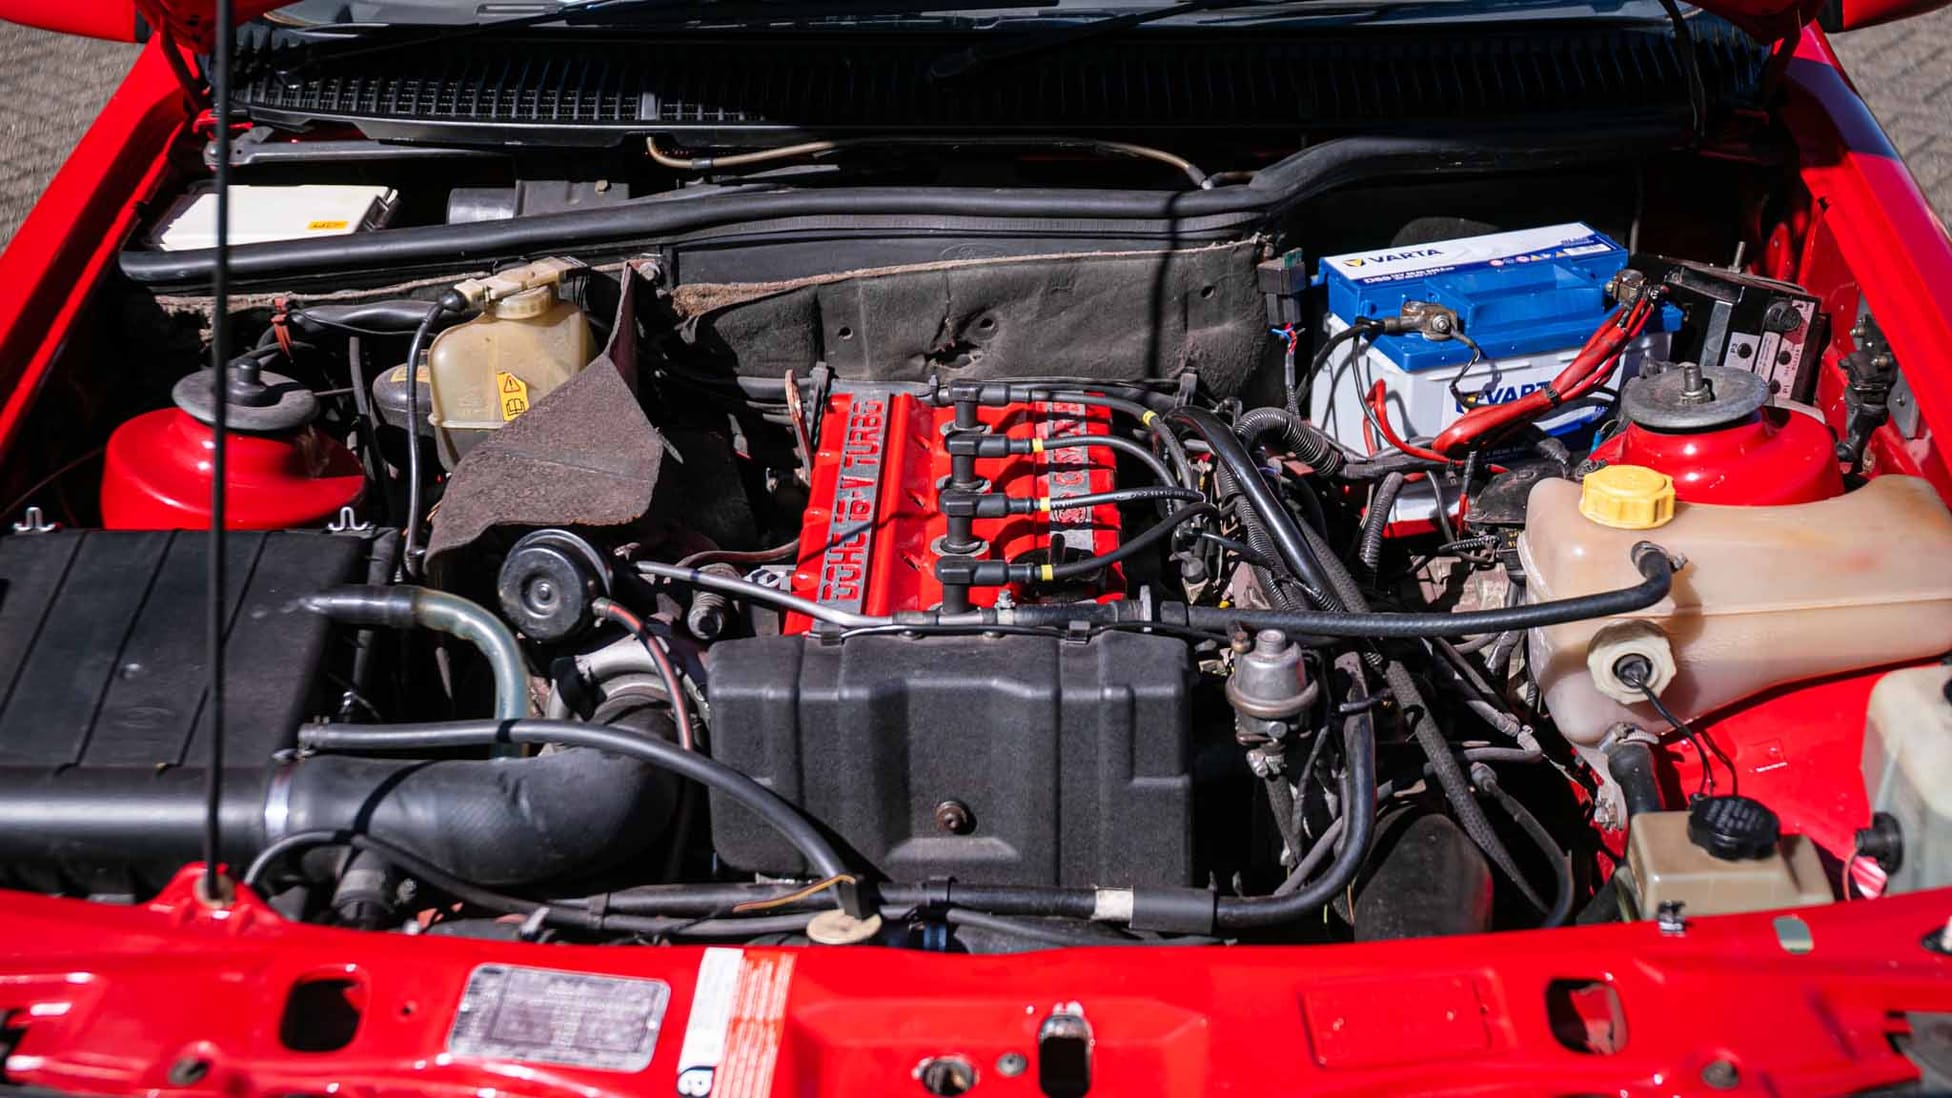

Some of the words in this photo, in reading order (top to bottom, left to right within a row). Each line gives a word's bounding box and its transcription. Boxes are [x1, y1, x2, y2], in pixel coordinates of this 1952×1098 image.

[1368, 248, 1444, 265] VARTA
[843, 400, 884, 468] TURBO
[821, 532, 867, 601] DOHC
